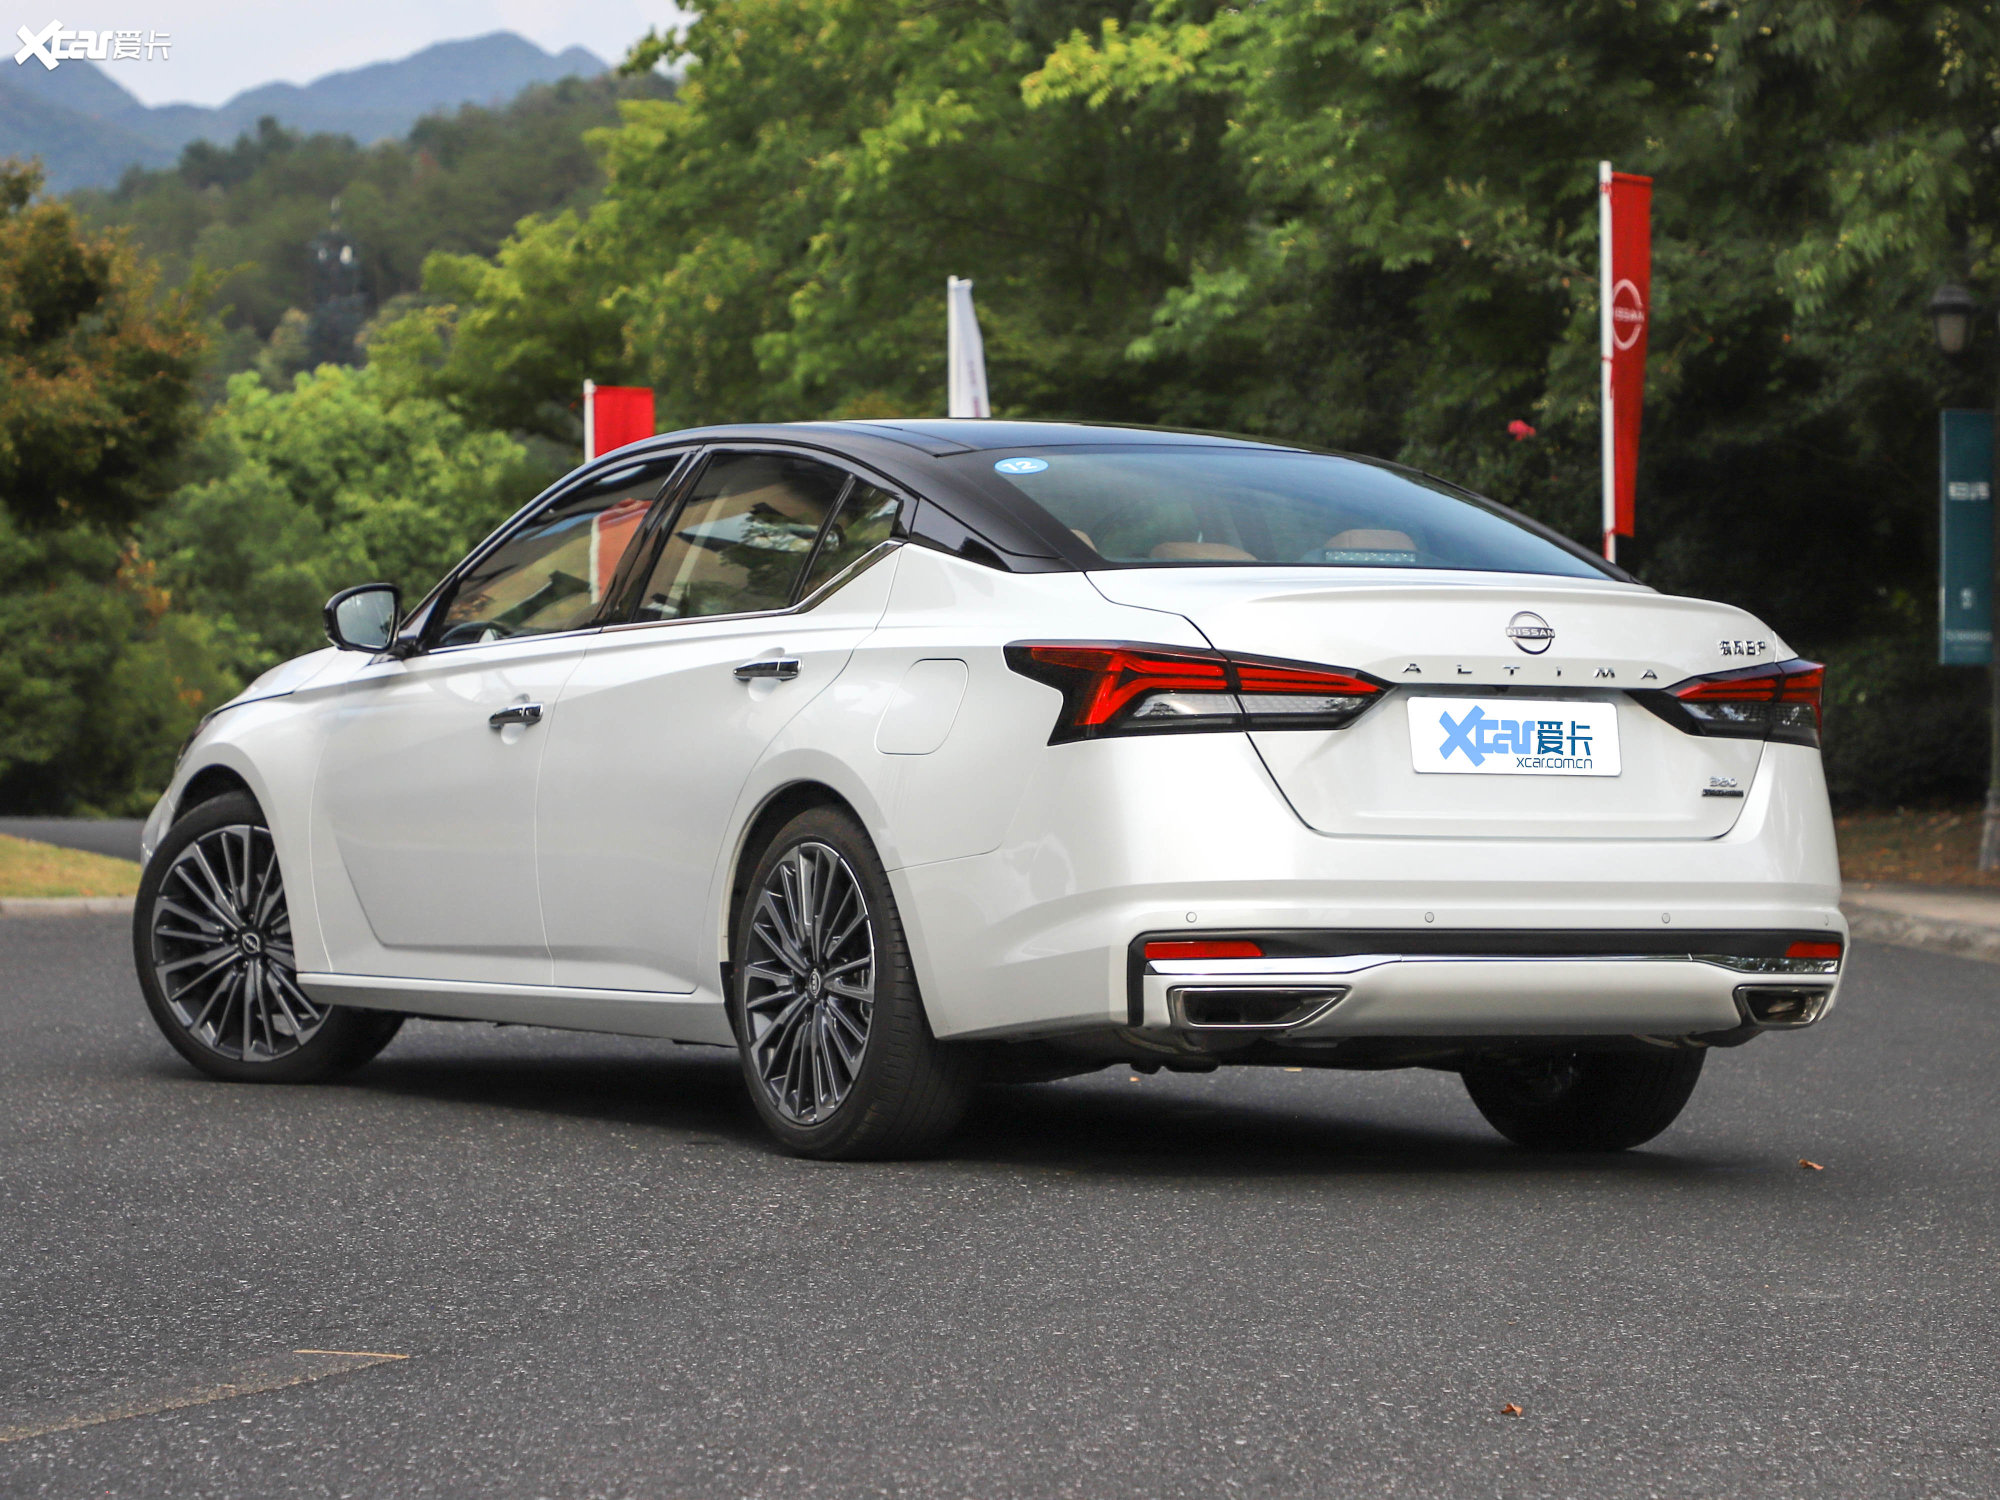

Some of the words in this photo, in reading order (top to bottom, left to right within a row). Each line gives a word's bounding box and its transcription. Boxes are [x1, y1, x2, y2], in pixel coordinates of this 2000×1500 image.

[1001, 460, 1038, 471] 12
[1507, 627, 1555, 639] NISSAN
[1402, 662, 1658, 681] ALTIMA
[1516, 757, 1593, 769] xcar.com.cn
